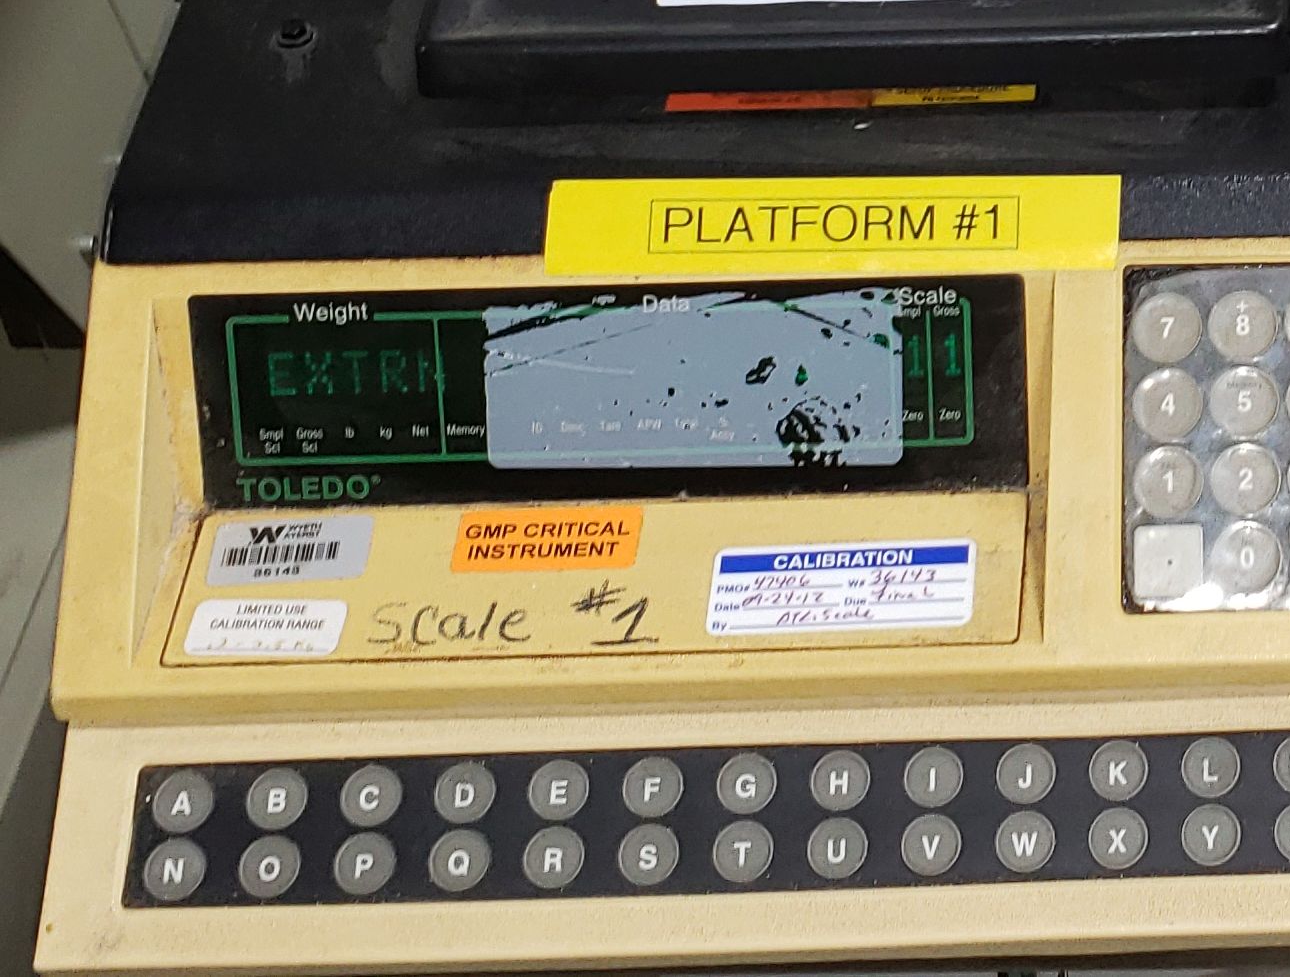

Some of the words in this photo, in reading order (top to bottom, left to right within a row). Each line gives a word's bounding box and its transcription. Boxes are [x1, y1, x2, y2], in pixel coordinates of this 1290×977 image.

[663, 203, 936, 243] PLATFORM
[953, 204, 1001, 239] #1
[642, 294, 690, 313] Data
[900, 285, 957, 306] Scale
[294, 302, 368, 325] Weight
[1236, 313, 1251, 336] 8
[1160, 317, 1175, 339] 7
[907, 334, 924, 377] 1
[944, 333, 961, 376] 1
[1160, 393, 1175, 415] 4
[1237, 390, 1252, 412] 5
[939, 407, 962, 421] Zero
[296, 426, 324, 439] Gross
[412, 424, 430, 438] Net
[446, 422, 486, 438] Memory
[236, 475, 371, 503] TOLEDO
[1162, 470, 1174, 493] 1
[1238, 467, 1253, 491] 2
[465, 522, 518, 540] GMP
[523, 520, 630, 539] CRITICAL
[467, 540, 621, 561] INSTRUMENT
[773, 548, 914, 571] CALIBRATION
[1240, 546, 1255, 569] 0
[236, 603, 283, 615] LIMITED
[285, 603, 308, 615] USE
[714, 601, 741, 613] Date
[844, 596, 867, 607] Due
[209, 618, 285, 630] CALIBRATION
[286, 618, 326, 630] RANGE
[829, 770, 849, 795] H
[1017, 763, 1033, 789] J
[1109, 761, 1129, 785] K
[1202, 758, 1218, 783] L
[359, 785, 380, 811] C
[454, 782, 475, 808] D
[548, 780, 568, 806] E
[643, 777, 662, 803] F
[735, 773, 757, 800] G
[170, 789, 191, 816] A
[266, 787, 287, 813] B
[828, 838, 846, 863] U
[921, 835, 941, 860] V
[1012, 832, 1039, 857] W
[1107, 829, 1128, 854] X
[1201, 826, 1221, 850] Y
[353, 852, 374, 879] P
[448, 849, 470, 878] Q
[542, 847, 563, 873] R
[638, 843, 658, 871] S
[733, 841, 753, 868] T
[163, 858, 184, 885] N
[258, 856, 281, 882] O
